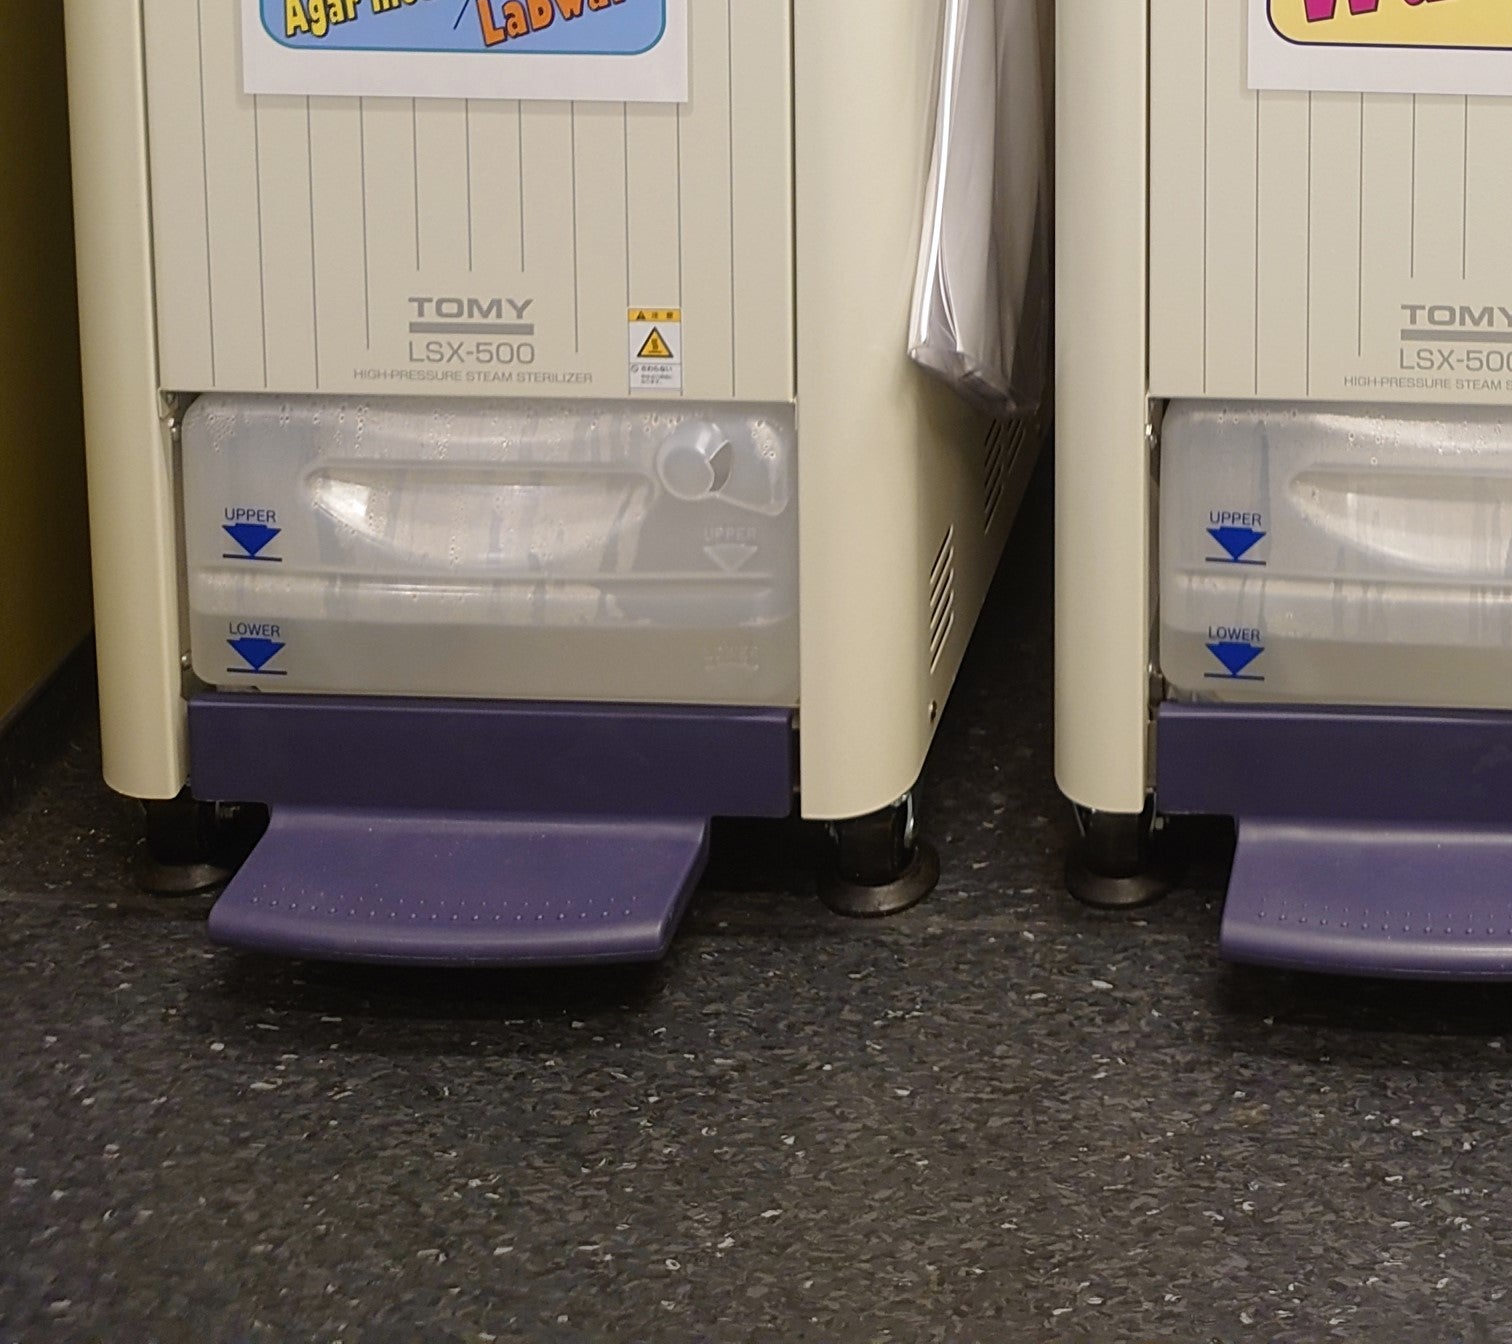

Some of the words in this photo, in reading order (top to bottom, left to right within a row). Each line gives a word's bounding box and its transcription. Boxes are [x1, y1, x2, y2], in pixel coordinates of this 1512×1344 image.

[408, 297, 534, 319] TOMY
[409, 341, 535, 364] LSX-500
[354, 369, 462, 381] HIGH-PRESSURE
[467, 371, 512, 382] STEAM
[517, 372, 592, 384] STERILIZER
[1345, 376, 1451, 388] HIGH-PRESSURE
[1456, 378, 1502, 390] STEAM
[225, 508, 276, 523] UPPER
[1209, 512, 1262, 527] UPPER
[228, 623, 280, 637] LOWER
[1208, 627, 1260, 642] LOWER
